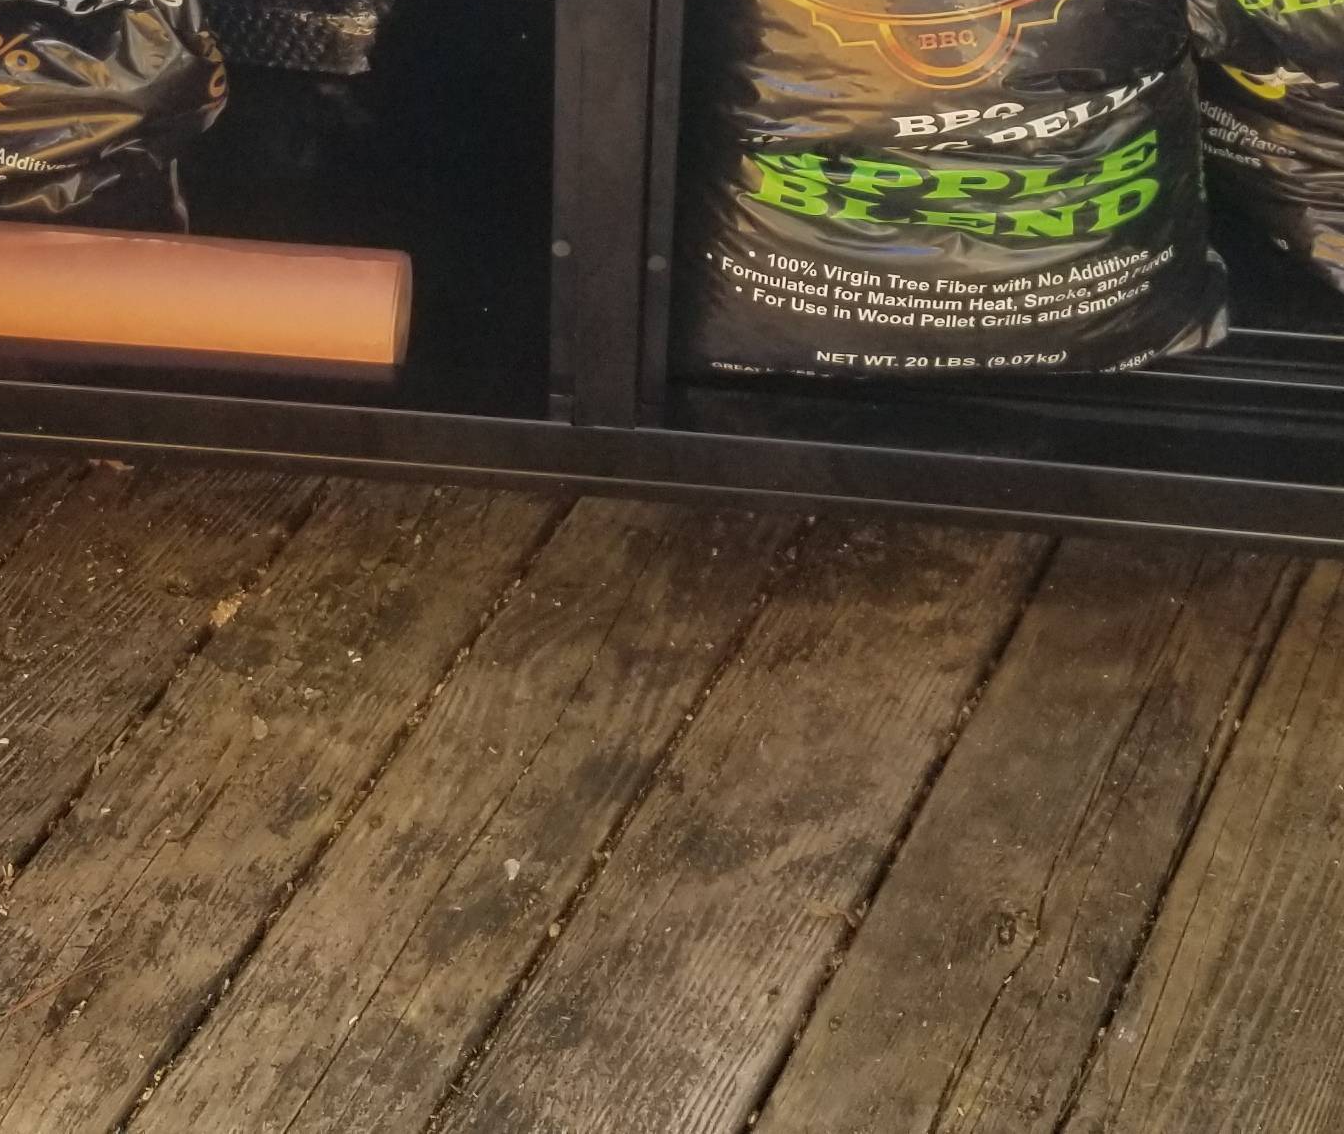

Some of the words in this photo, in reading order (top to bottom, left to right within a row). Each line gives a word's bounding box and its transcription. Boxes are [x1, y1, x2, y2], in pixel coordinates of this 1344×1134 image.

[918, 29, 978, 50] BBQ
[892, 102, 1024, 138] BBQ
[1200, 101, 1259, 137] dditives
[747, 165, 1159, 237] BLEND
[721, 256, 829, 297] Formulated
[834, 286, 862, 302] for
[867, 290, 962, 311] Maximum
[969, 297, 1018, 313] Heat,
[1024, 287, 1092, 309] Smoke,
[1097, 271, 1129, 293] and
[767, 253, 818, 277] 100%
[823, 264, 881, 287] Virgin
[887, 273, 929, 291] Tree
[936, 279, 987, 294] Fiber
[992, 279, 1032, 293] with
[1038, 272, 1064, 288] No
[1068, 249, 1150, 283] Additives
[752, 287, 786, 308] For
[791, 296, 828, 316] Use
[833, 305, 851, 320] in
[858, 307, 915, 326] Wood
[920, 313, 975, 328] Pellet
[981, 313, 1032, 328] Grills
[1037, 304, 1072, 323] and
[1076, 279, 1151, 315] Smokers
[816, 350, 859, 365] NET
[864, 354, 899, 367] WT.
[904, 357, 929, 368] 20
[934, 357, 981, 368] LBS.
[987, 353, 1035, 368] (9.07
[1037, 349, 1068, 364] kg)
